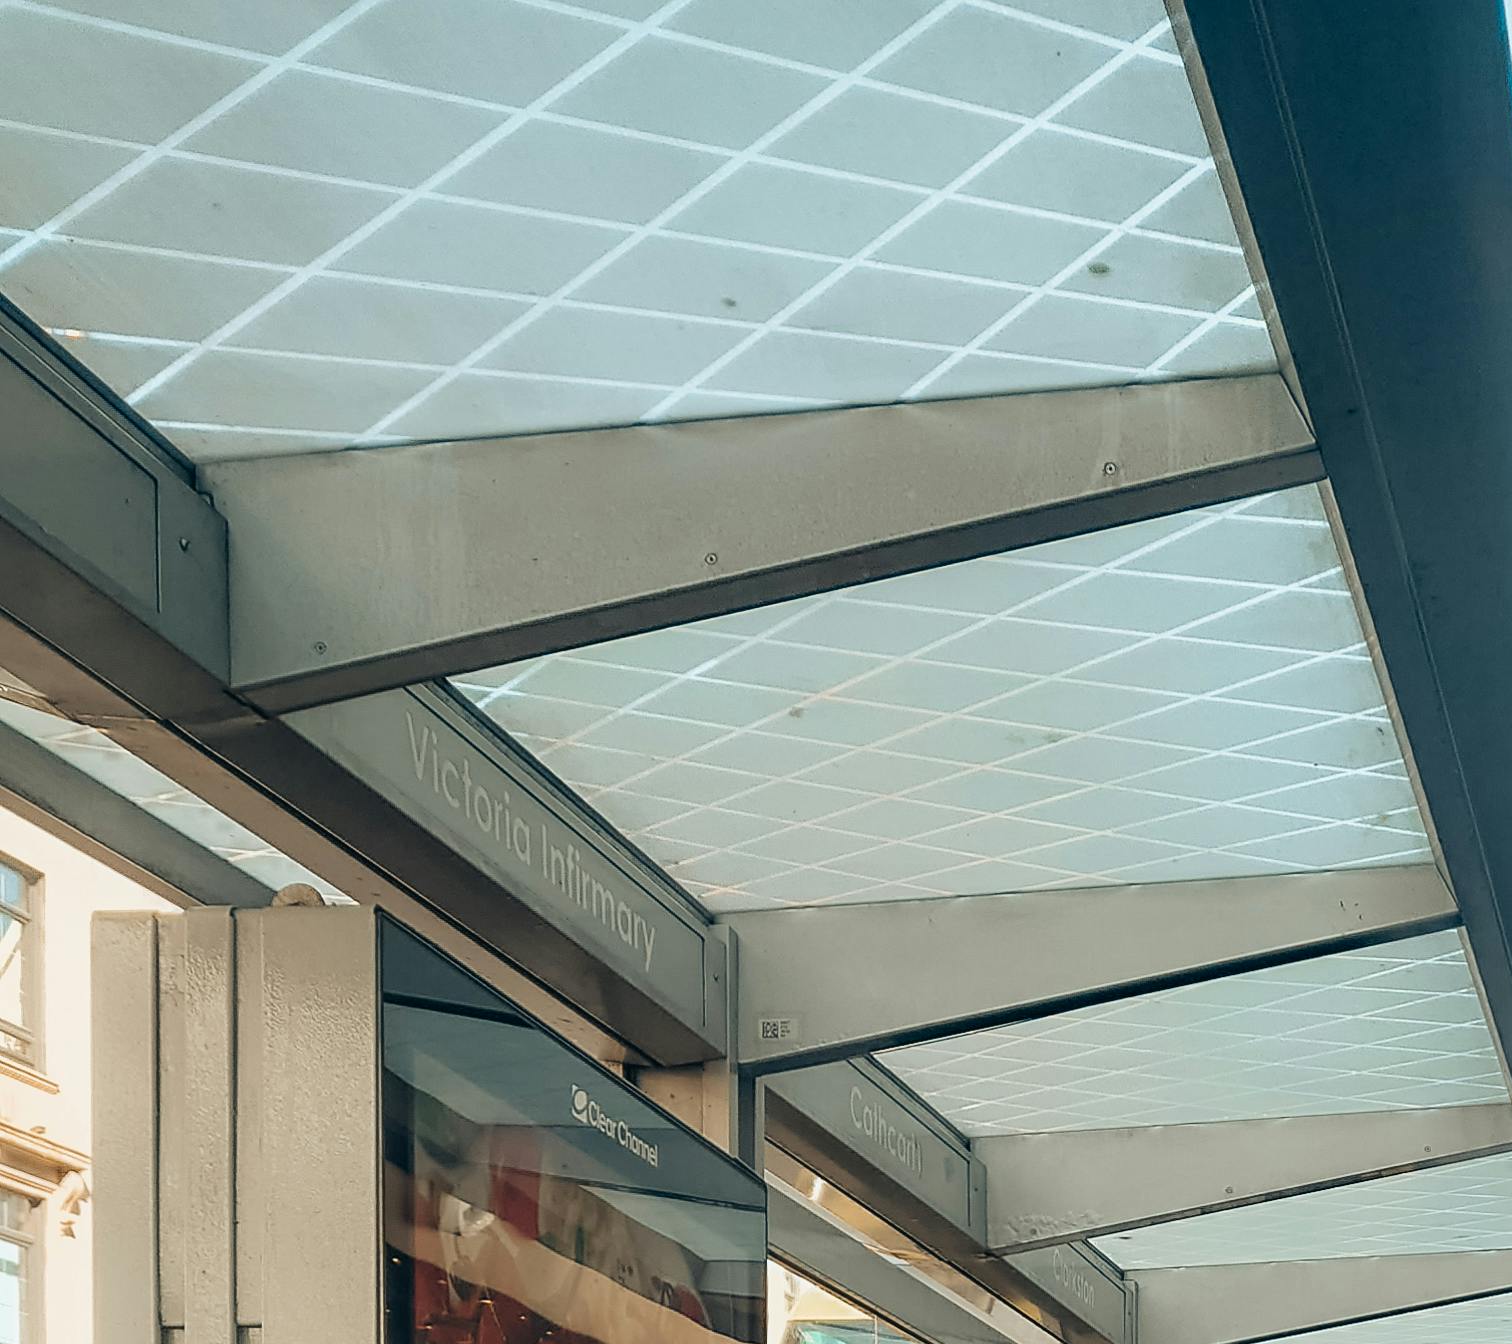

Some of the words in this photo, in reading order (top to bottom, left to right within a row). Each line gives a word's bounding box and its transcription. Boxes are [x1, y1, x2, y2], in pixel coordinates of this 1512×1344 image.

[406, 711, 531, 866] Victoria
[542, 823, 656, 973] Infirmary
[588, 1100, 617, 1139] Clear
[618, 1121, 658, 1168] Channel
